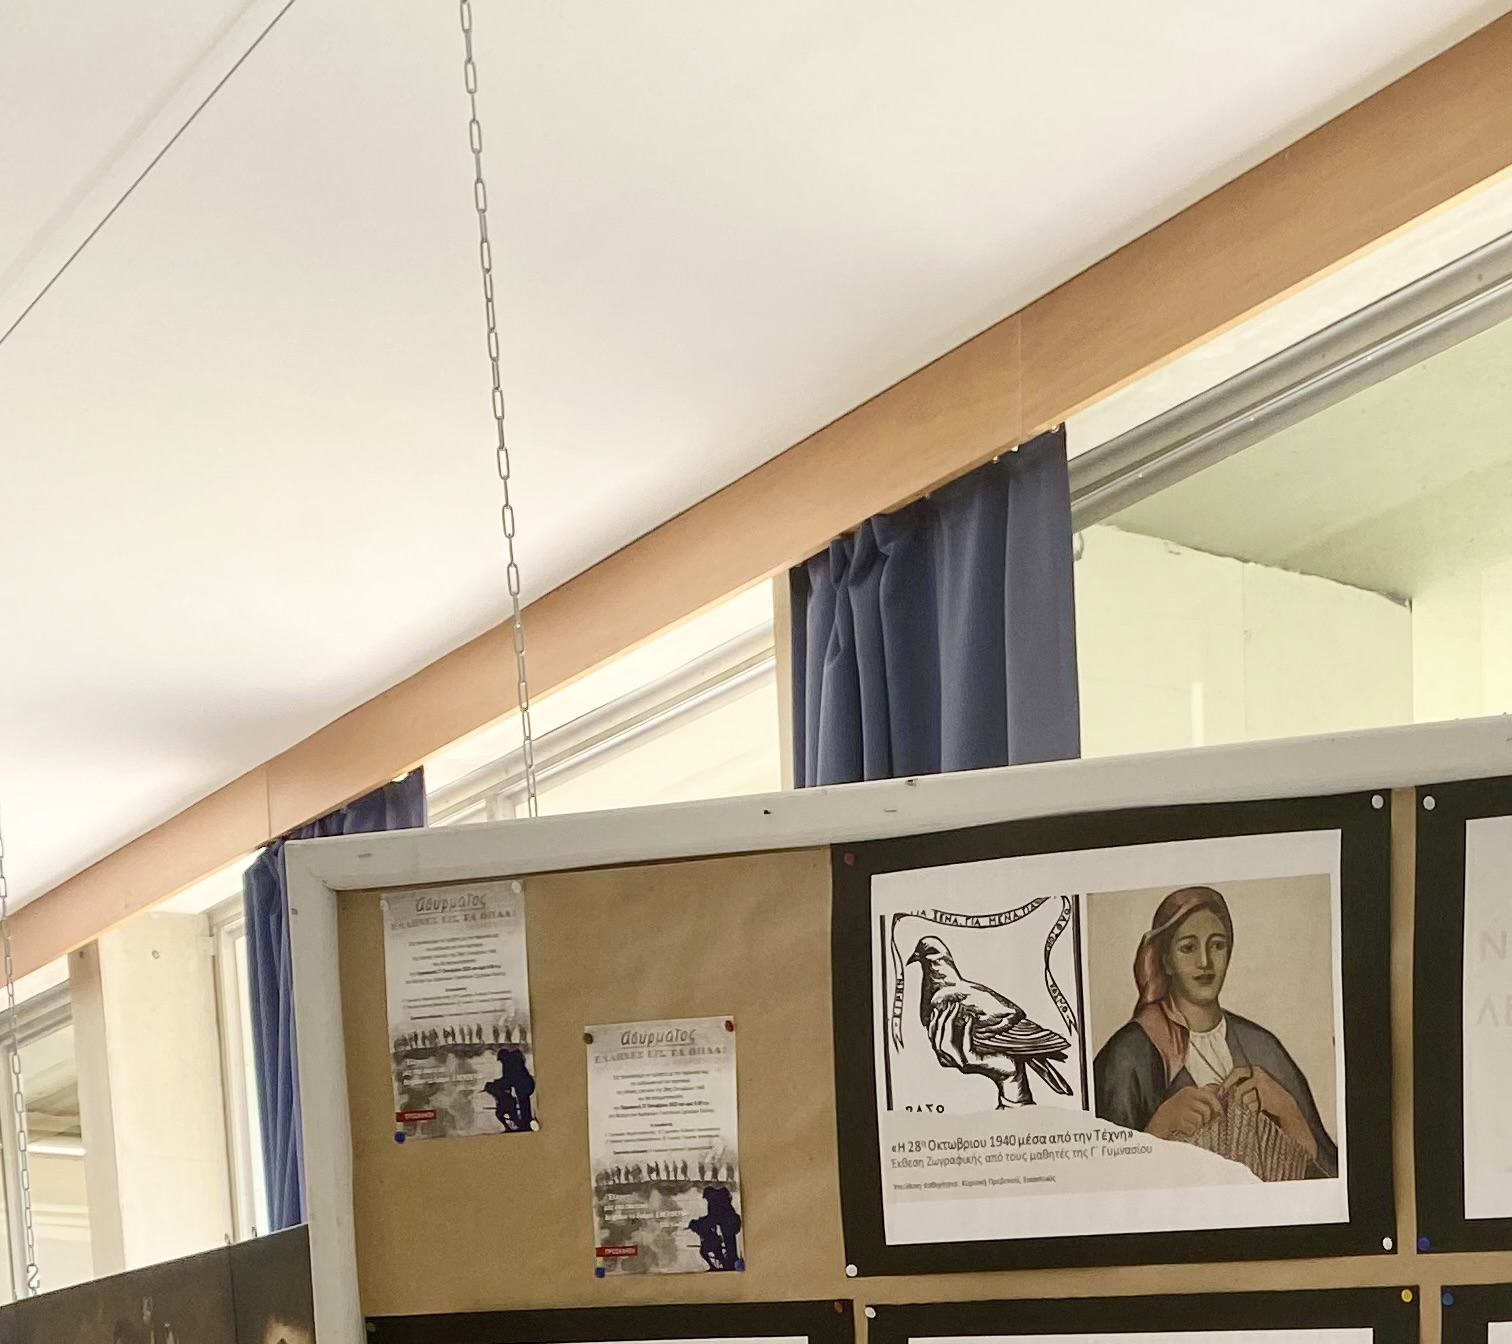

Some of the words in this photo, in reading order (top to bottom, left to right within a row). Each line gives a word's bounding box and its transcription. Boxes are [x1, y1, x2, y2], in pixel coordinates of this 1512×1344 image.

[990, 1135, 1016, 1148] 1940
[1018, 1132, 1047, 1149] μέσα
[1049, 1131, 1072, 1146] από
[1073, 1132, 1092, 1147] την
[1092, 1128, 1134, 1146] Τέχνη»
